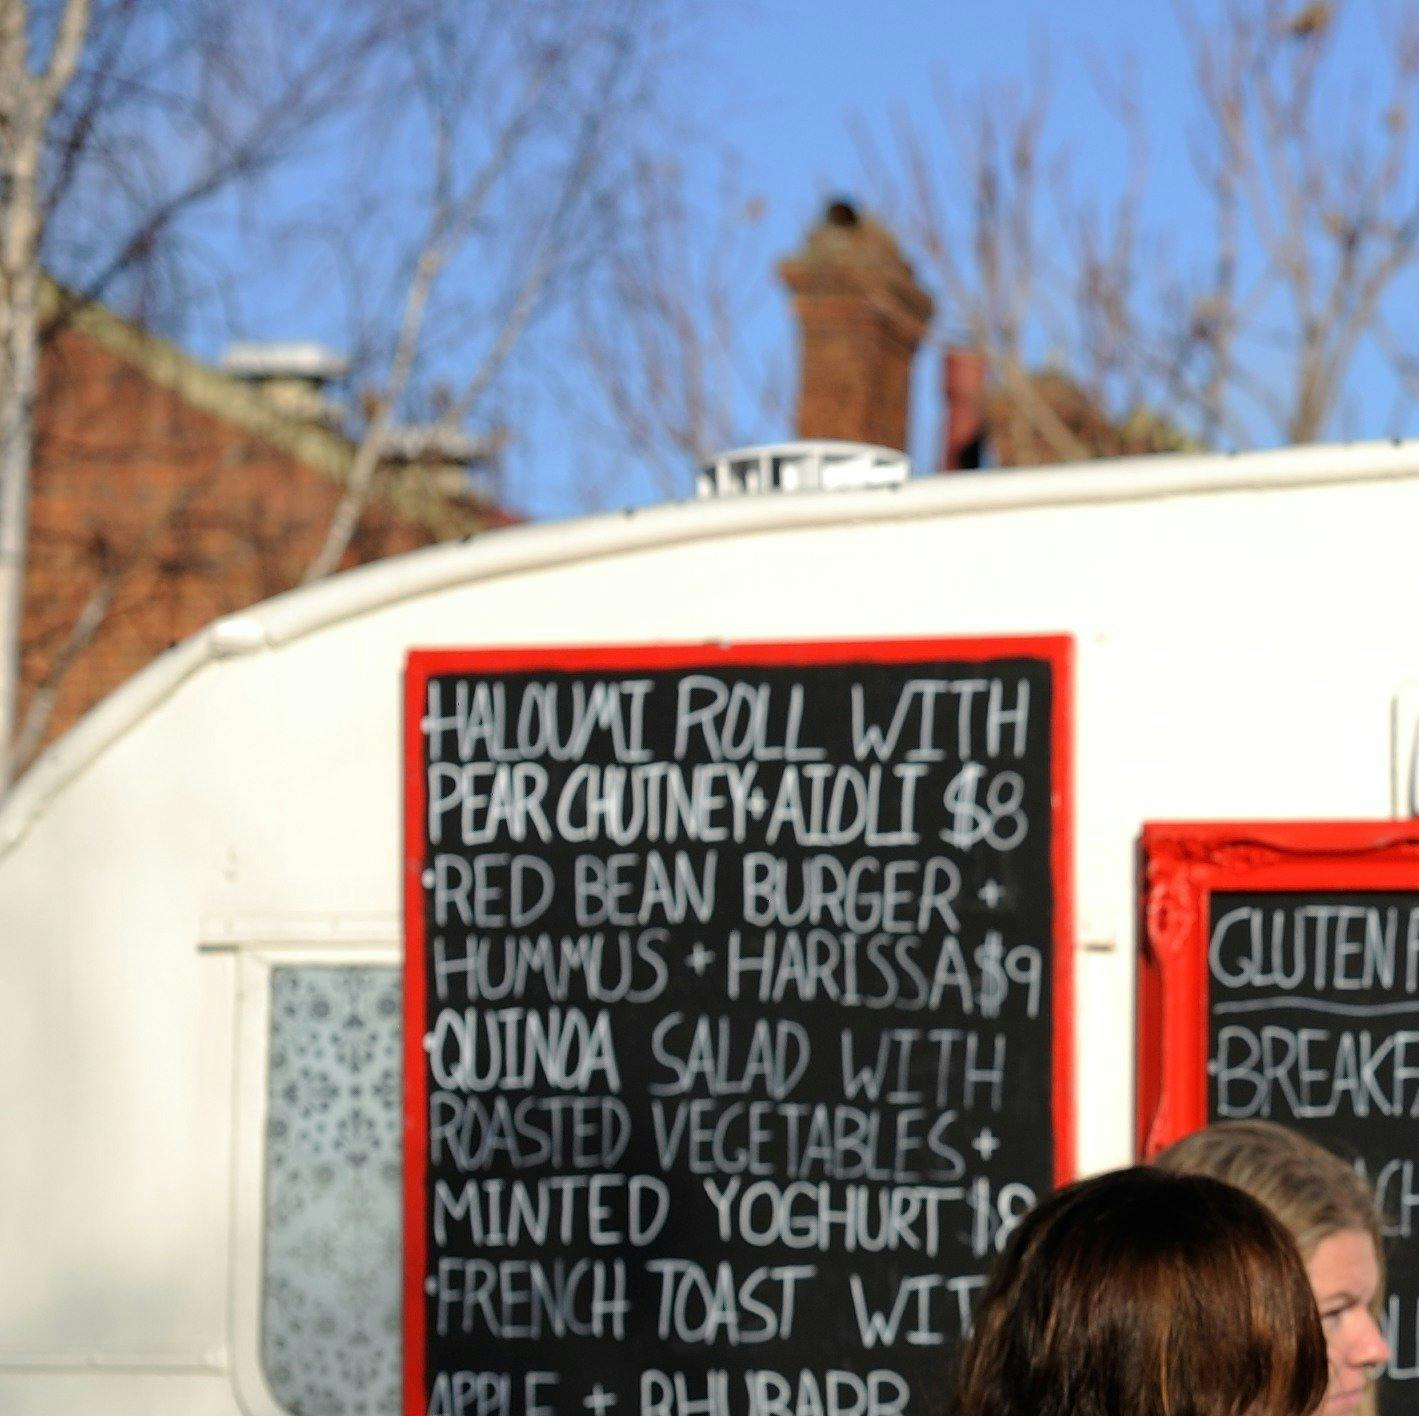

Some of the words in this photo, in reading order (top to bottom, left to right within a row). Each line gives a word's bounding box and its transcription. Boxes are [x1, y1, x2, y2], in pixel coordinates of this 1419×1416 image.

[427, 678, 655, 763] HALOUMI
[674, 675, 827, 761] ROLL
[851, 677, 1029, 762] WITH
[428, 761, 552, 846] PEAR
[556, 760, 758, 847] CHUTNEY
[765, 762, 921, 847] AIOLI
[938, 761, 1030, 851] $8
[434, 853, 555, 928] RED
[574, 849, 719, 927] BEAN
[742, 851, 963, 934] BURGER
[433, 928, 671, 1002] HUMMUS
[1208, 904, 1399, 991] GLUTEN
[429, 1005, 622, 1093] QUINOA
[648, 1011, 812, 1099] SALAD
[840, 1027, 1006, 1109] WITH
[430, 1093, 632, 1173] ROASTED
[650, 1099, 969, 1182] VEGETABLES
[433, 1174, 672, 1247] MINTED
[701, 1175, 965, 1259] YOGHURT
[436, 1256, 630, 1339] FRENCH
[646, 1257, 817, 1346] TOAST
[849, 1272, 990, 1350] WIT
